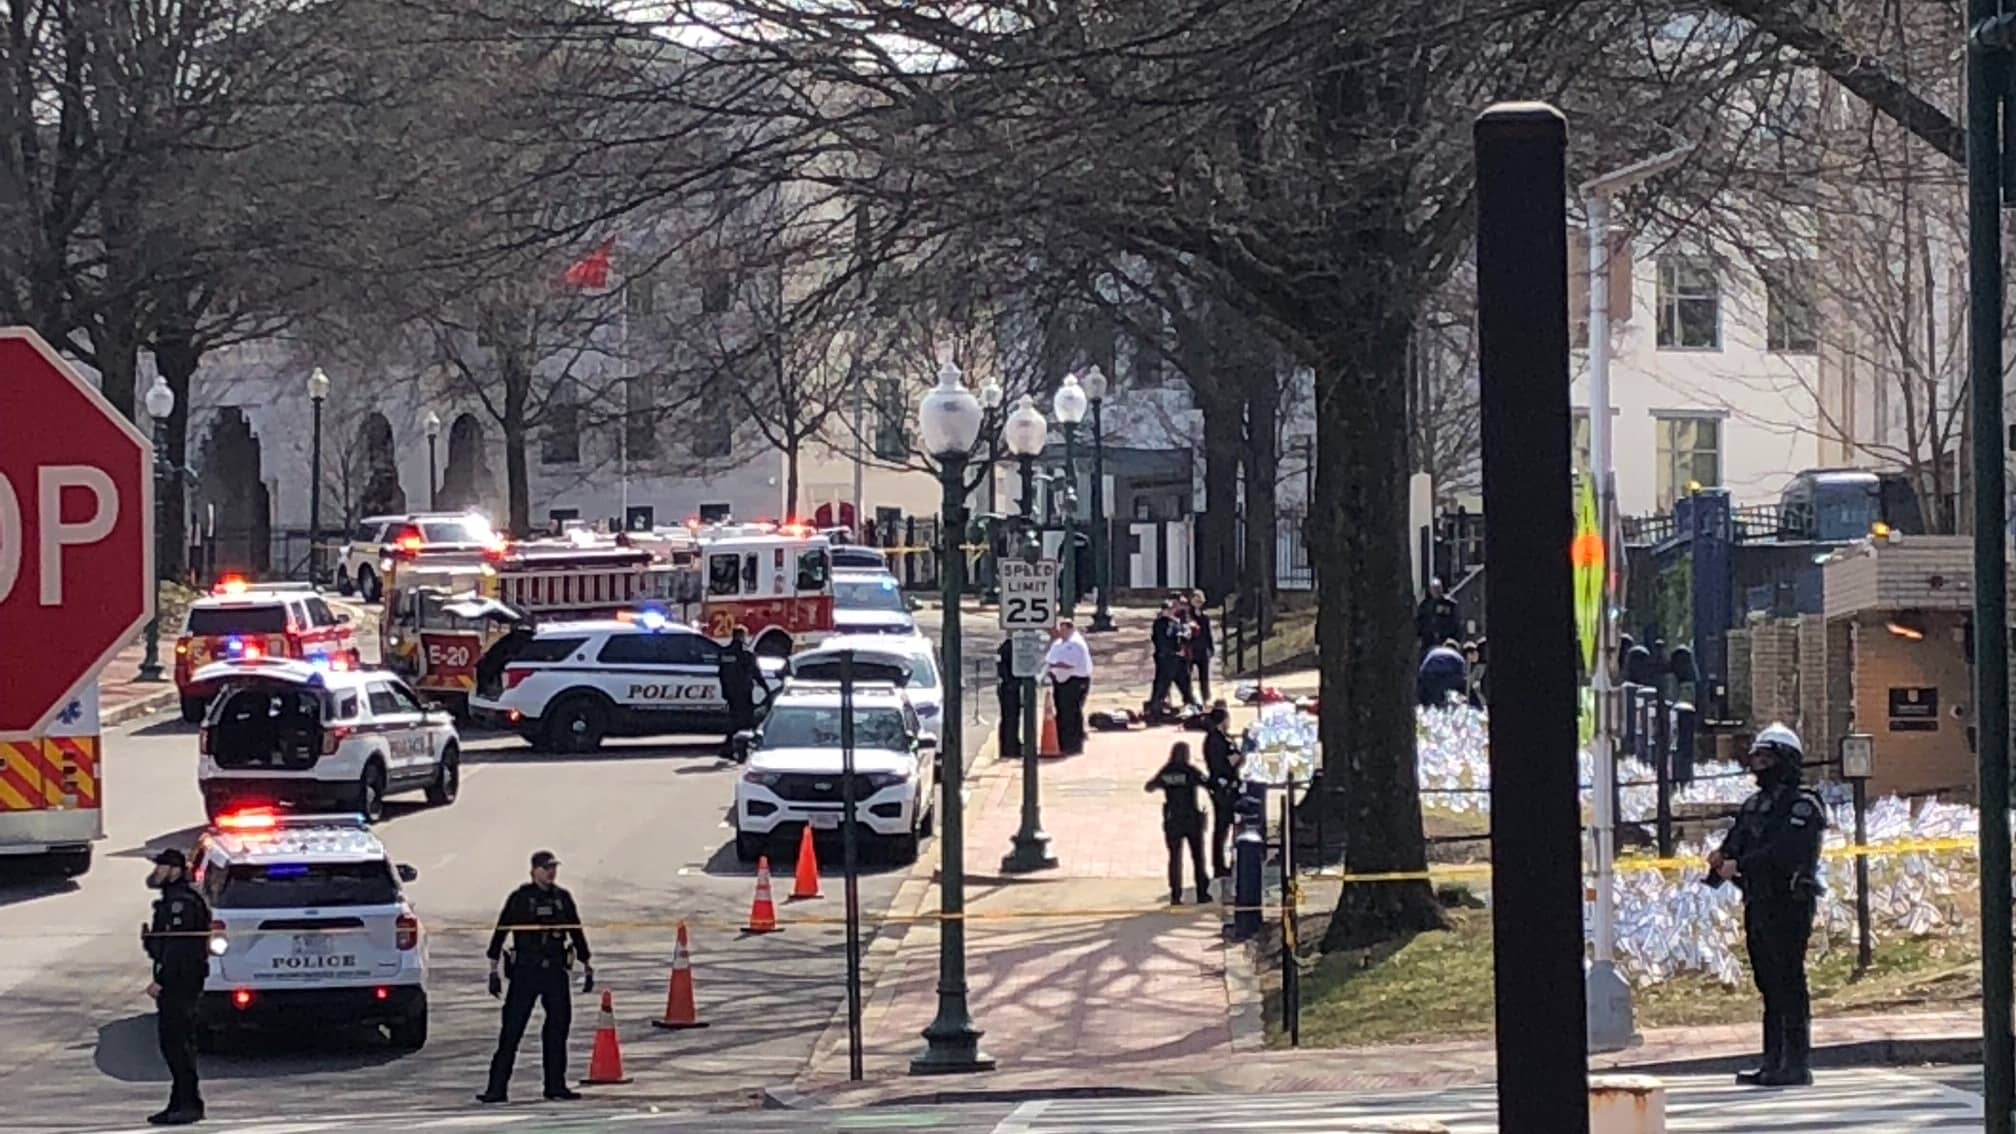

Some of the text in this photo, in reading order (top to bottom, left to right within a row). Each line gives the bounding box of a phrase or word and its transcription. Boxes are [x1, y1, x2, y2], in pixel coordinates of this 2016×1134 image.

[0, 464, 119, 605] P
[1004, 565, 1052, 577] SPEED
[1008, 582, 1047, 592] LIMIT
[1006, 598, 1049, 622] 25
[713, 611, 735, 637] 20
[429, 644, 470, 667] E-20
[627, 684, 716, 700] POLICE
[271, 955, 356, 968] POLICE
